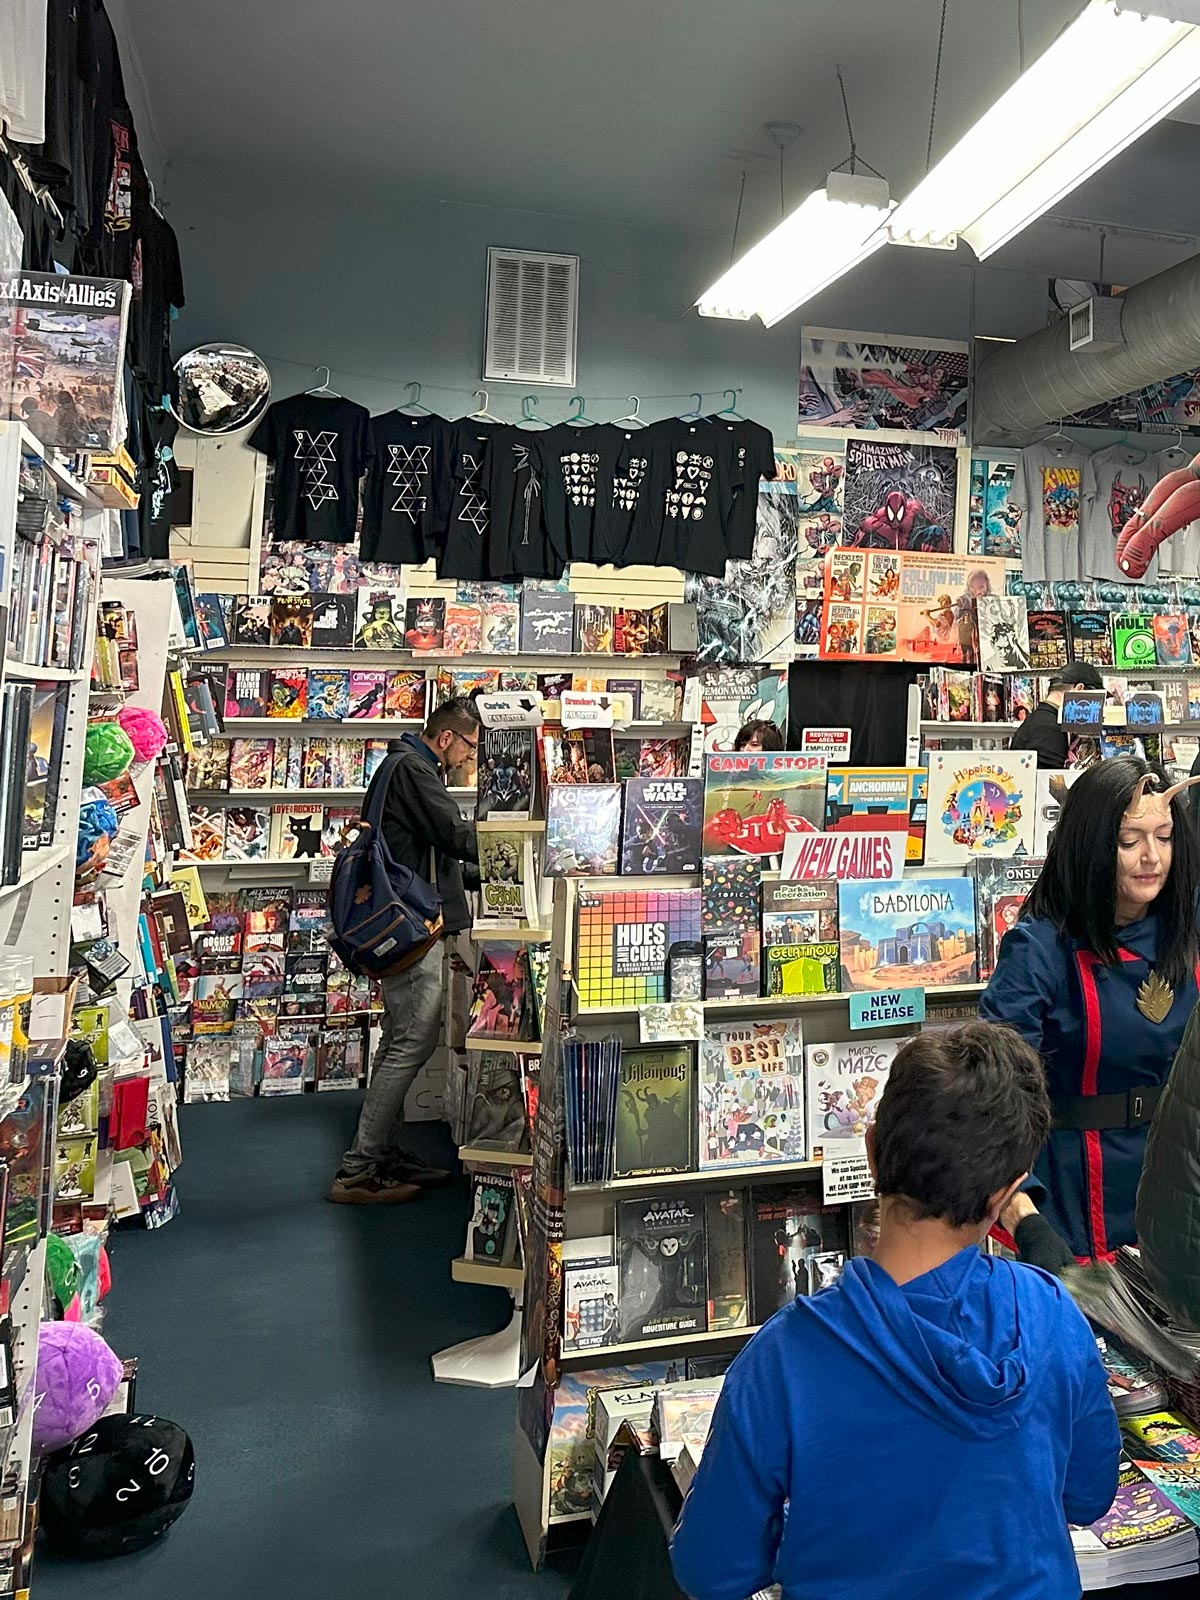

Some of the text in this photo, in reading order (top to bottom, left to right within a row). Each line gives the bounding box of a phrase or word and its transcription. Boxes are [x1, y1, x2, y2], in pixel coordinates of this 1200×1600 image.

[19, 279, 116, 308] Axis Allies
[860, 443, 901, 456] AMAZING
[848, 450, 916, 472] SPIDER-MAN
[834, 554, 863, 562] RECKLESS
[902, 569, 965, 585] FOLLOW ME
[902, 582, 935, 596] DOWN
[237, 672, 260, 681] BLOOD
[236, 689, 260, 699] TEETH
[730, 684, 757, 696] WARS
[1162, 683, 1183, 697] THE
[565, 697, 596, 706] Brandon's
[709, 756, 825, 772] CAN'T STOP!
[953, 764, 1014, 783] Happiest Day
[648, 783, 684, 792] STAR
[849, 781, 907, 793] ANCHORMAN
[643, 790, 687, 801] WARS
[273, 805, 322, 813] LOVE ROCKETS
[790, 837, 893, 879] NEW GAMES
[485, 884, 521, 906] GOON
[775, 891, 826, 899] Recreation
[873, 893, 955, 915] BABYLONIA
[617, 923, 665, 946] HUES
[203, 937, 235, 947] ROGUES
[617, 947, 629, 962] AND
[630, 945, 665, 962] CUES
[770, 945, 838, 958] GELATINOUS
[199, 1000, 229, 1010] NAMOR
[871, 994, 900, 1006] NEW
[861, 1006, 914, 1022] RELEASE
[724, 1031, 752, 1043] YOUR
[729, 1040, 781, 1065] BEST
[848, 1046, 878, 1057] MAGIC
[761, 1061, 784, 1074] LIFE
[838, 1055, 888, 1075] MAZE
[620, 1064, 687, 1085] Villainous
[850, 1164, 867, 1172] Special
[643, 1208, 695, 1223] AVATAR
[573, 1278, 611, 1289] AVATAR
[642, 1320, 697, 1334] ADVENTURE GUIDE
[87, 1378, 101, 1400] 5
[69, 1433, 99, 1456] 12
[144, 1447, 170, 1476] 10
[68, 1465, 81, 1489] 3
[116, 1479, 143, 1502] 2
